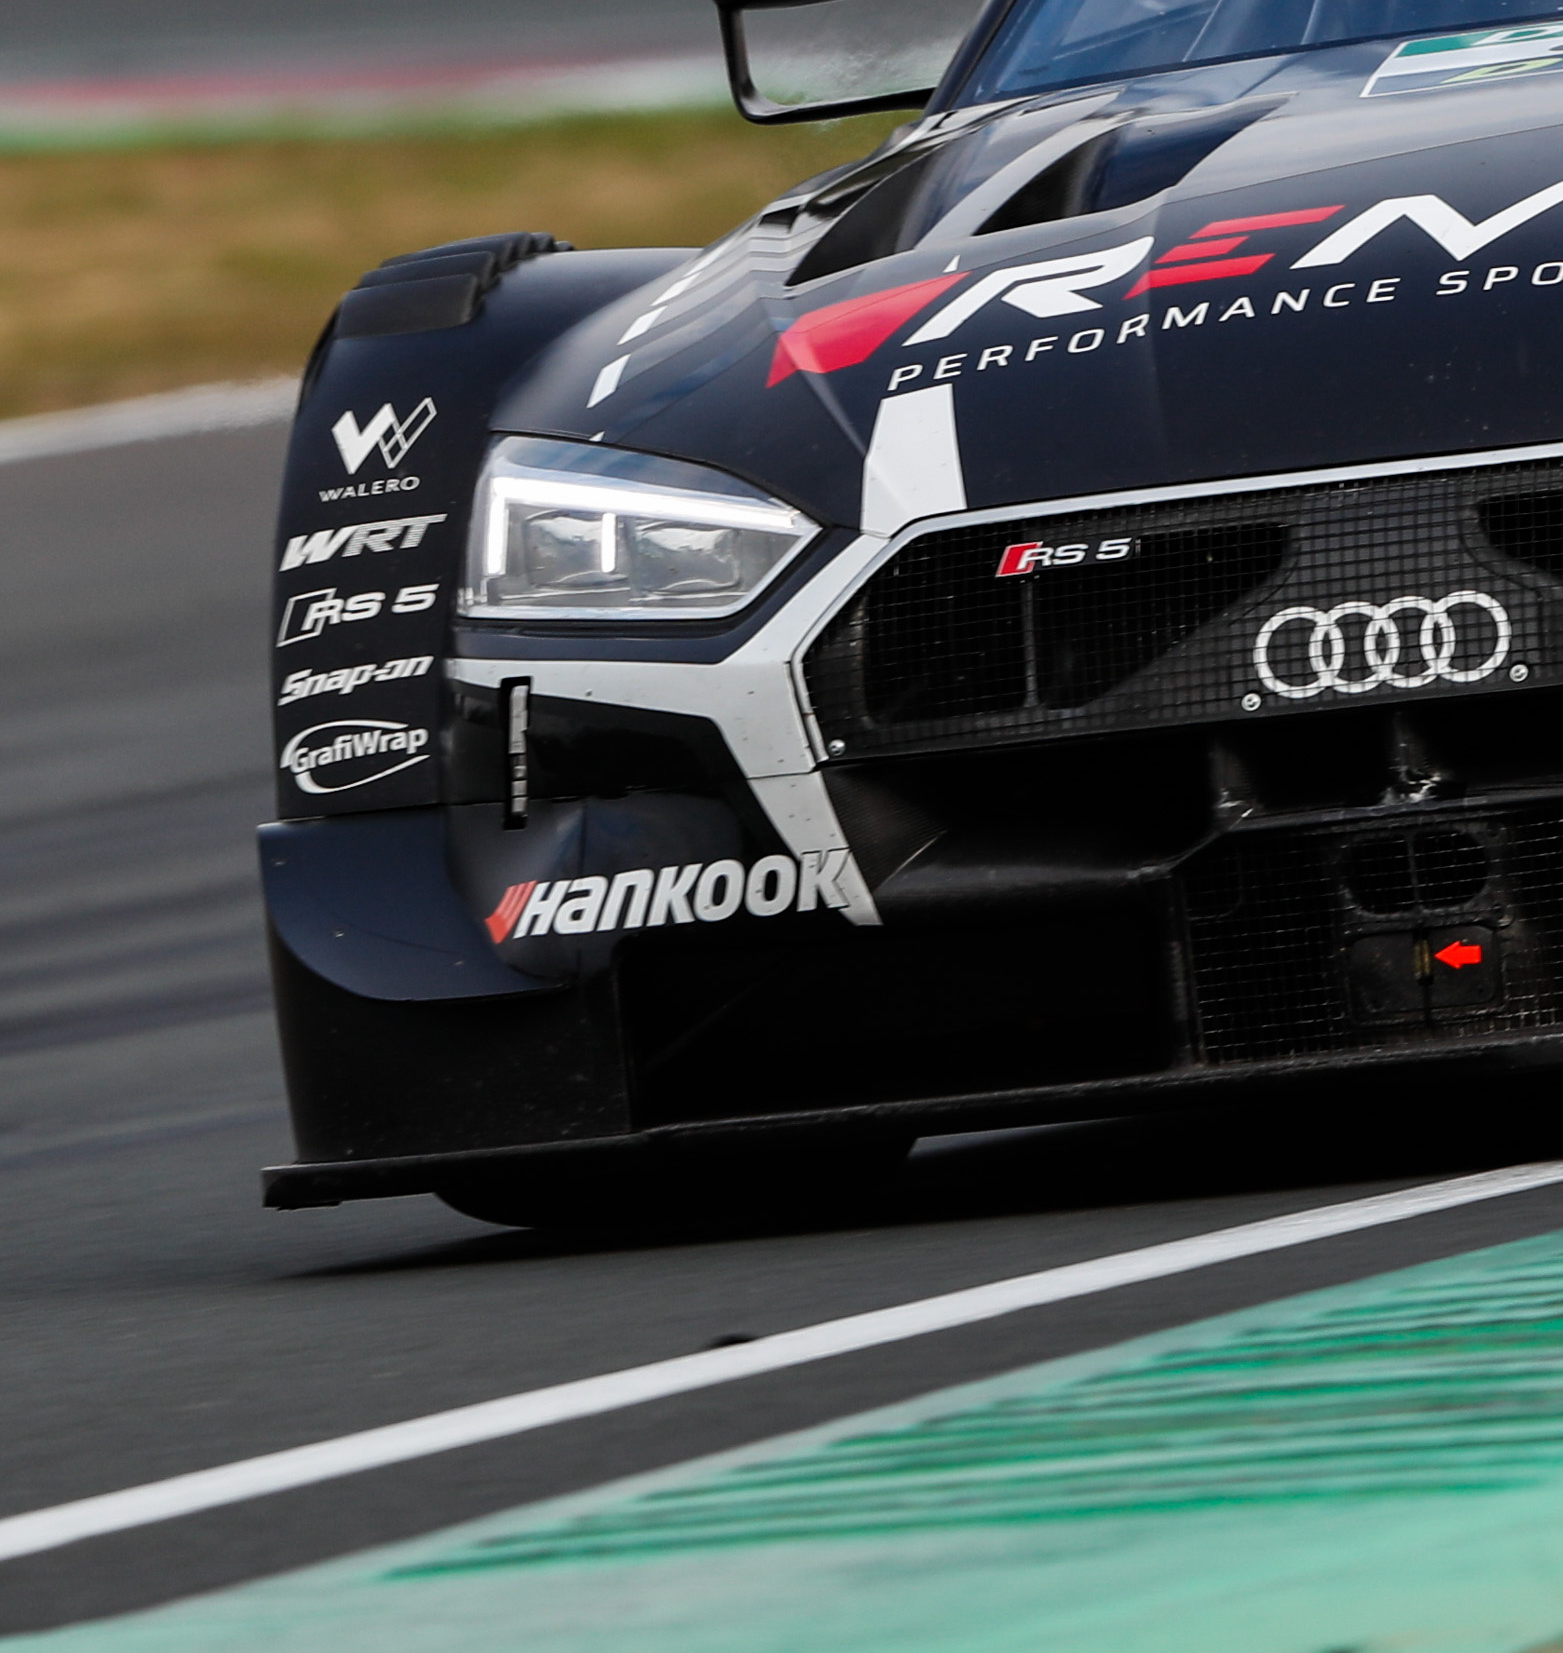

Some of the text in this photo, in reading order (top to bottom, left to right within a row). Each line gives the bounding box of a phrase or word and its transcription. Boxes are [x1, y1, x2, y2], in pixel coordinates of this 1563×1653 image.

[887, 276, 1400, 391] PERFORMANCE
[319, 476, 420, 502] WALERO
[279, 513, 448, 572] WRT
[1016, 537, 1133, 571] RS 5
[300, 583, 440, 632] RS 5
[277, 655, 434, 707] Snap-on
[289, 728, 429, 774] GrafiWrap
